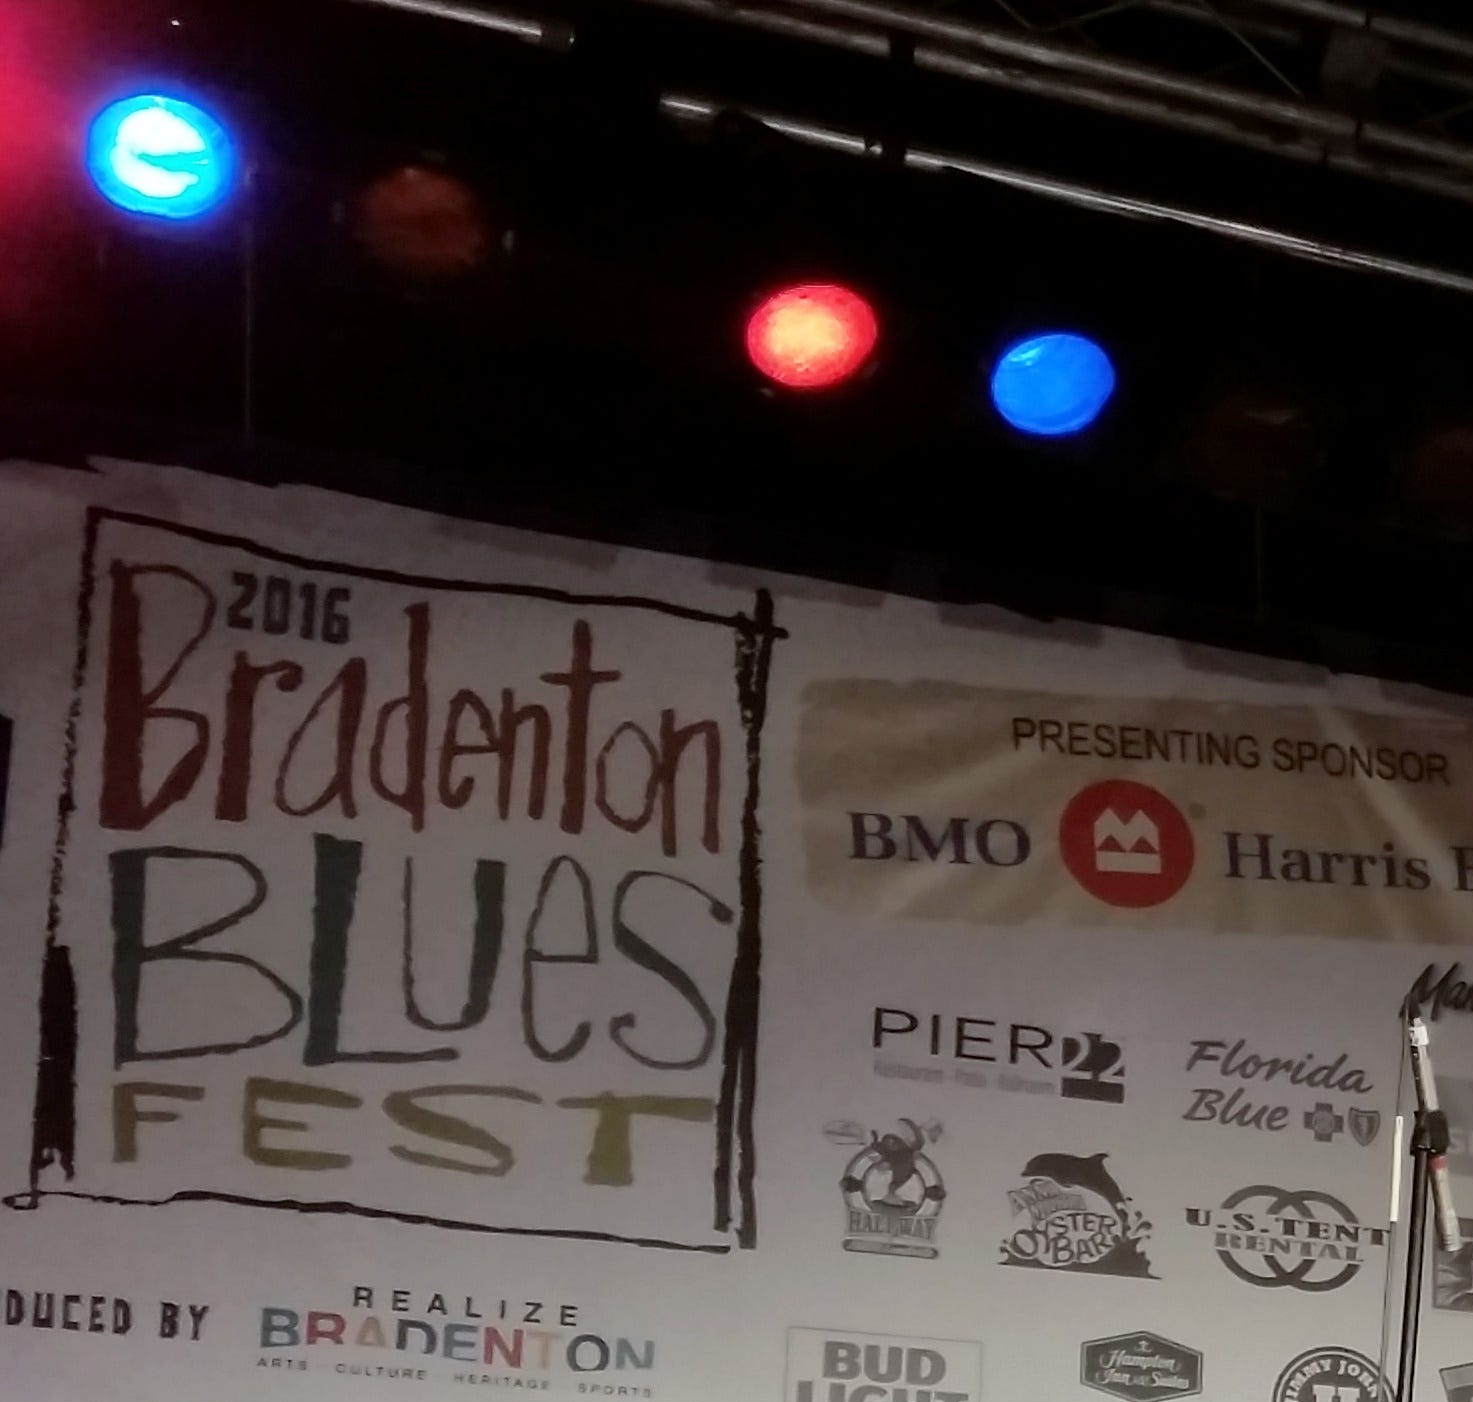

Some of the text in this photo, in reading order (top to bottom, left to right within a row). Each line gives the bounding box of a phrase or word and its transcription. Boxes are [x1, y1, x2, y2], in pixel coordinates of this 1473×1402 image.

[226, 571, 351, 644] 2016
[100, 558, 720, 858] Bradenton
[1011, 717, 1452, 787] PRESENTING SPONSOR
[843, 810, 1032, 867] BMO
[1223, 830, 1432, 892] Harris
[1185, 1038, 1375, 1094] Florida
[112, 1077, 715, 1187] FEST
[1181, 1086, 1290, 1132] Blue
[1213, 1232, 1364, 1263] RENTAL
[0, 1288, 209, 1340] DUCED BY
[353, 1285, 580, 1327] REALIZE
[258, 1306, 656, 1373] BRADENTON
[822, 1340, 947, 1387] BUD
[256, 1356, 310, 1371] ARTS
[334, 1362, 428, 1382] CULTURE
[453, 1371, 552, 1391] HERITAGE
